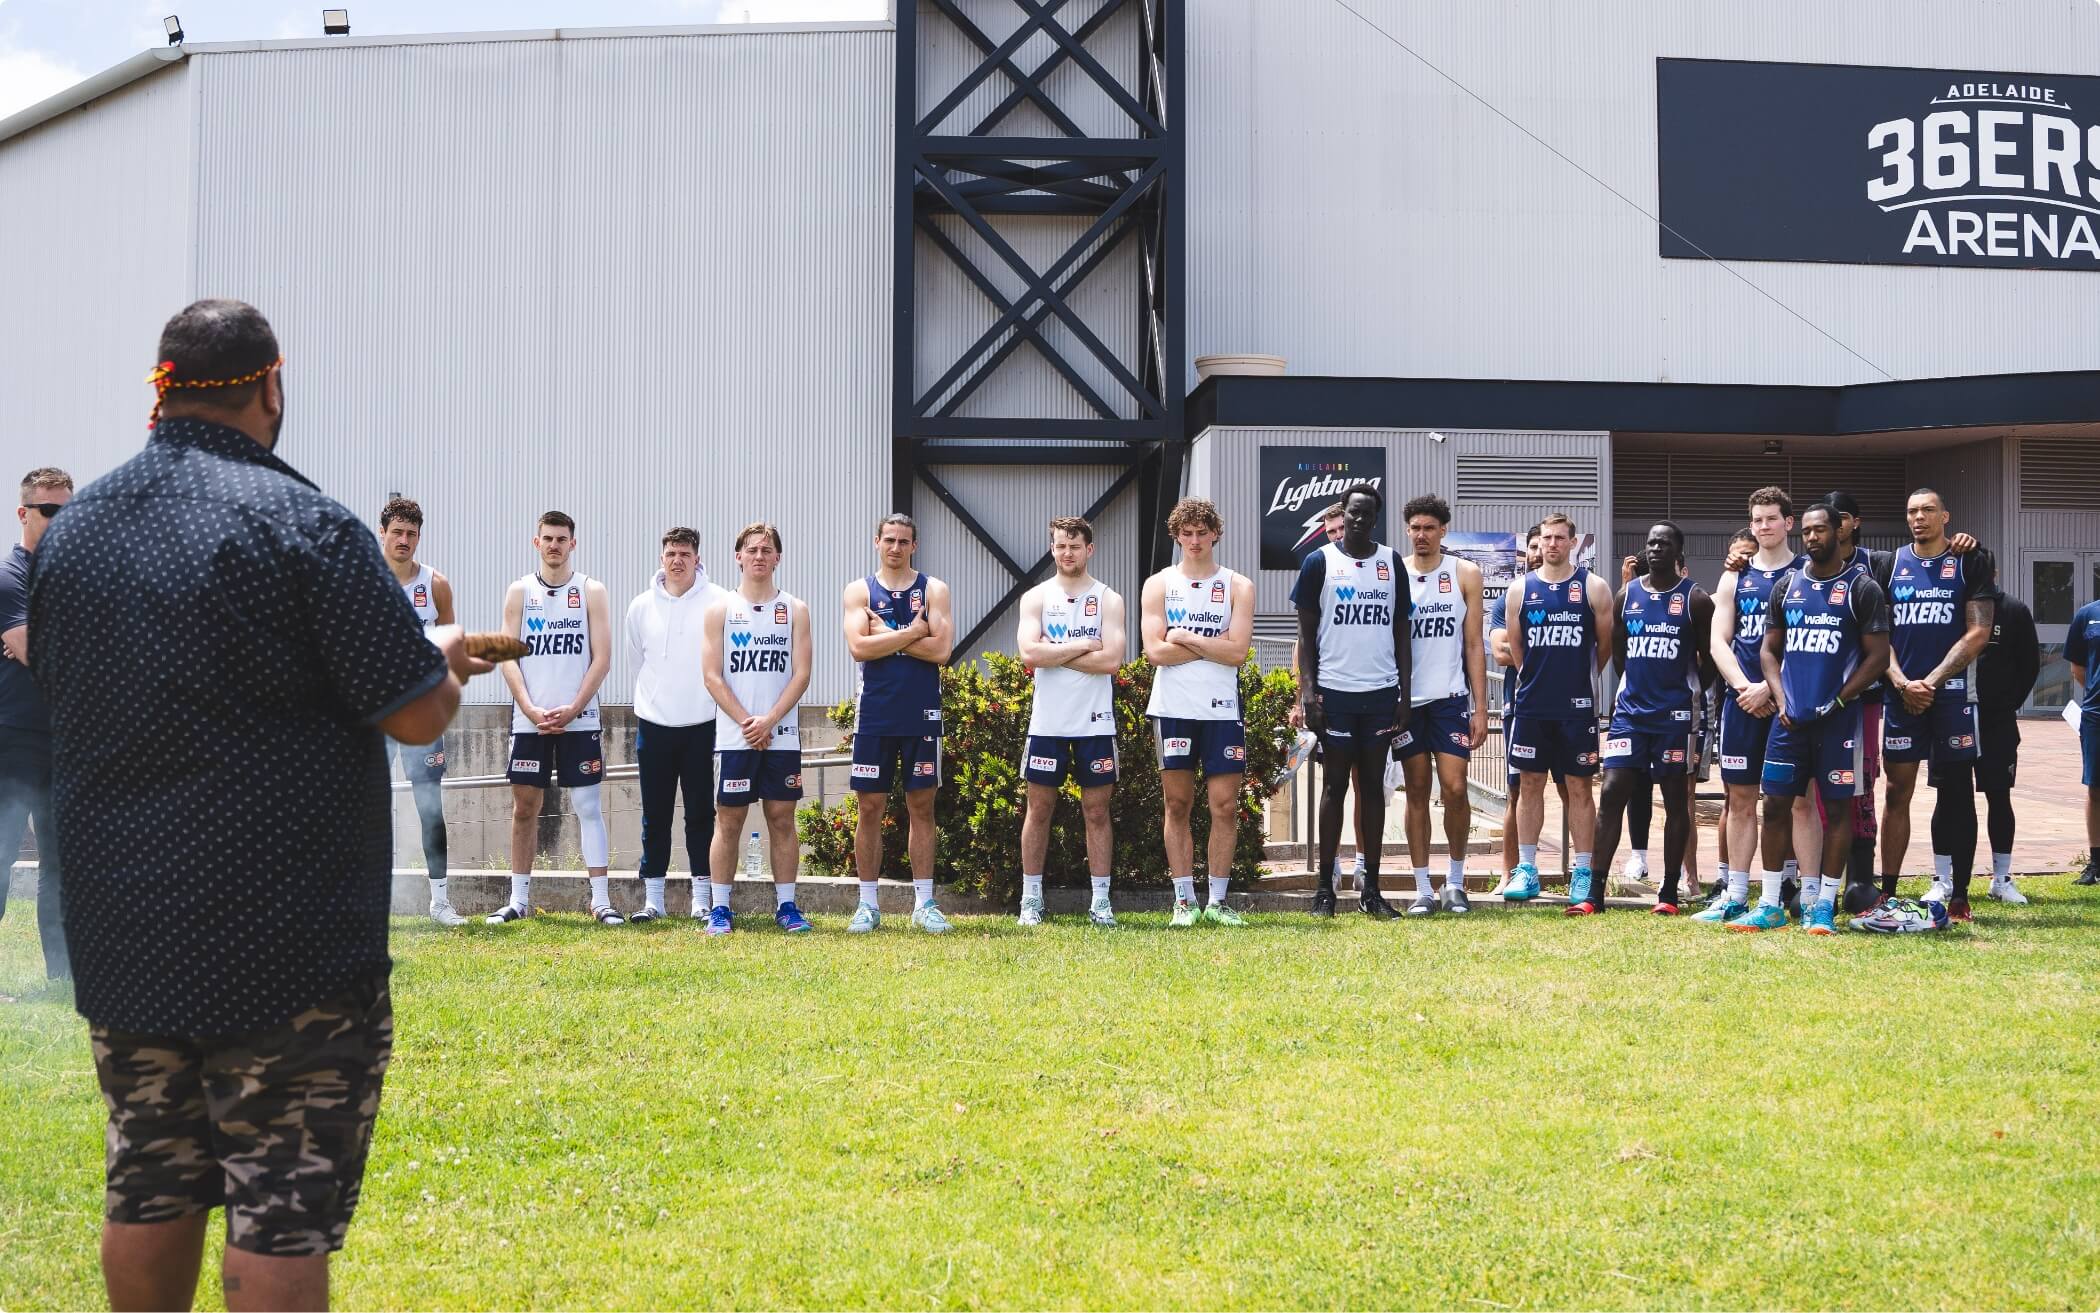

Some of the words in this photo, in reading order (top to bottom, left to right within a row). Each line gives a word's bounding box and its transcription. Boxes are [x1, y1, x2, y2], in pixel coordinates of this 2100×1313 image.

[1947, 84, 2056, 103] ADELAIDE
[1867, 110, 2100, 202] 36ER
[1902, 209, 2100, 260] ARENA
[1298, 463, 1350, 471] ADELAIDE
[1915, 587, 1954, 599] walker
[1188, 611, 1224, 623] walker
[1333, 603, 1391, 626] SIXERS
[1419, 602, 1454, 614] walker
[1548, 610, 1582, 622] walker
[1893, 601, 1955, 627] SIXERS
[547, 617, 583, 630] walker
[1645, 621, 1681, 635] walker
[1740, 614, 1767, 638] SIX
[1804, 613, 1843, 627] walker
[753, 633, 788, 646] walker
[1067, 625, 1098, 638] walker
[1527, 625, 1584, 648] SIXERS
[1786, 627, 1842, 654] SIXERS
[525, 633, 585, 656] SIXERS
[1626, 635, 1681, 660] SIXERS
[730, 649, 790, 674] SIXERS
